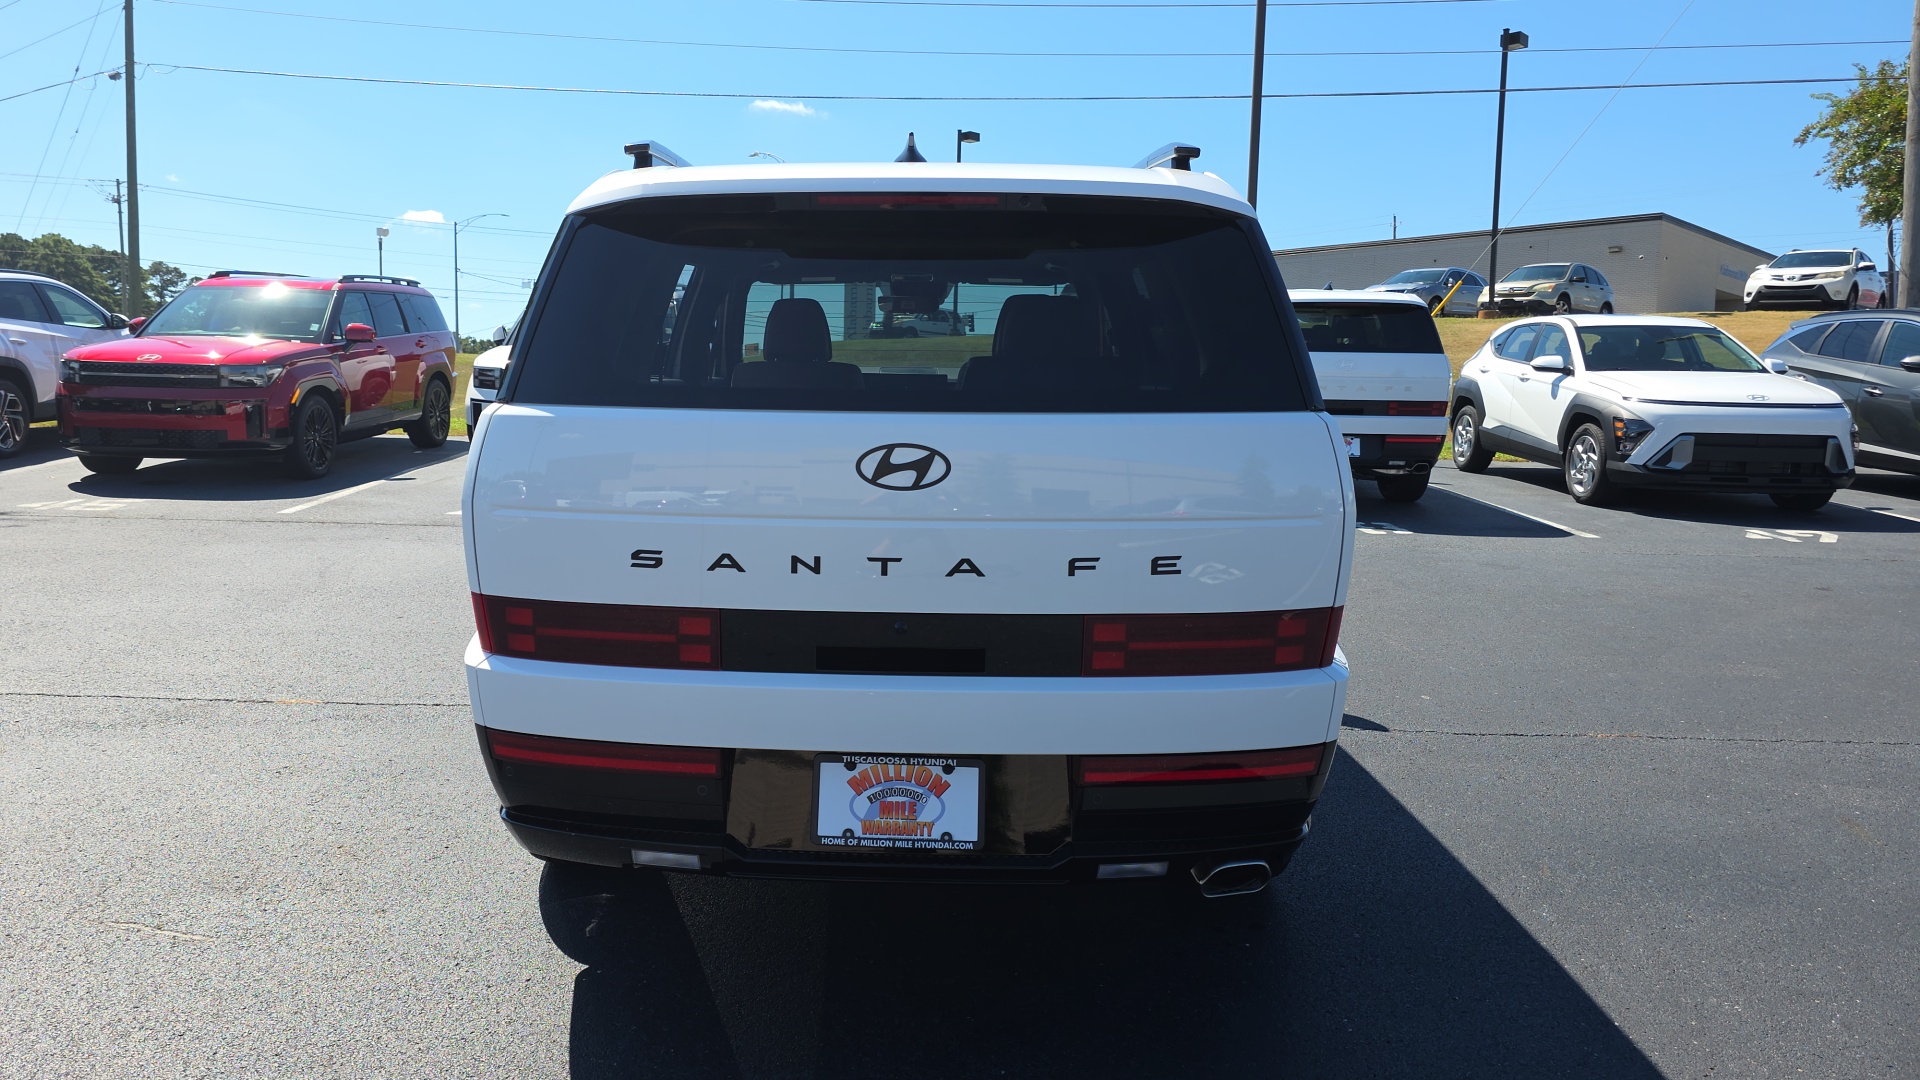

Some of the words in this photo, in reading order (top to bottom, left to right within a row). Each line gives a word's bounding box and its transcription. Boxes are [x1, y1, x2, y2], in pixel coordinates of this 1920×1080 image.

[630, 549, 986, 578] SANTA
[1067, 555, 1183, 577] FE
[843, 755, 907, 765] TUSCALOOSA
[910, 758, 957, 767] HYUNDAI
[847, 764, 951, 797] MILLION
[879, 800, 918, 820] MILE
[861, 820, 934, 837] WARRANTY
[821, 838, 846, 846] HOME
[847, 838, 859, 846] OF
[860, 839, 893, 848] MILLION
[895, 840, 913, 848] MILE
[915, 840, 974, 850] HYUNDAI.COM
